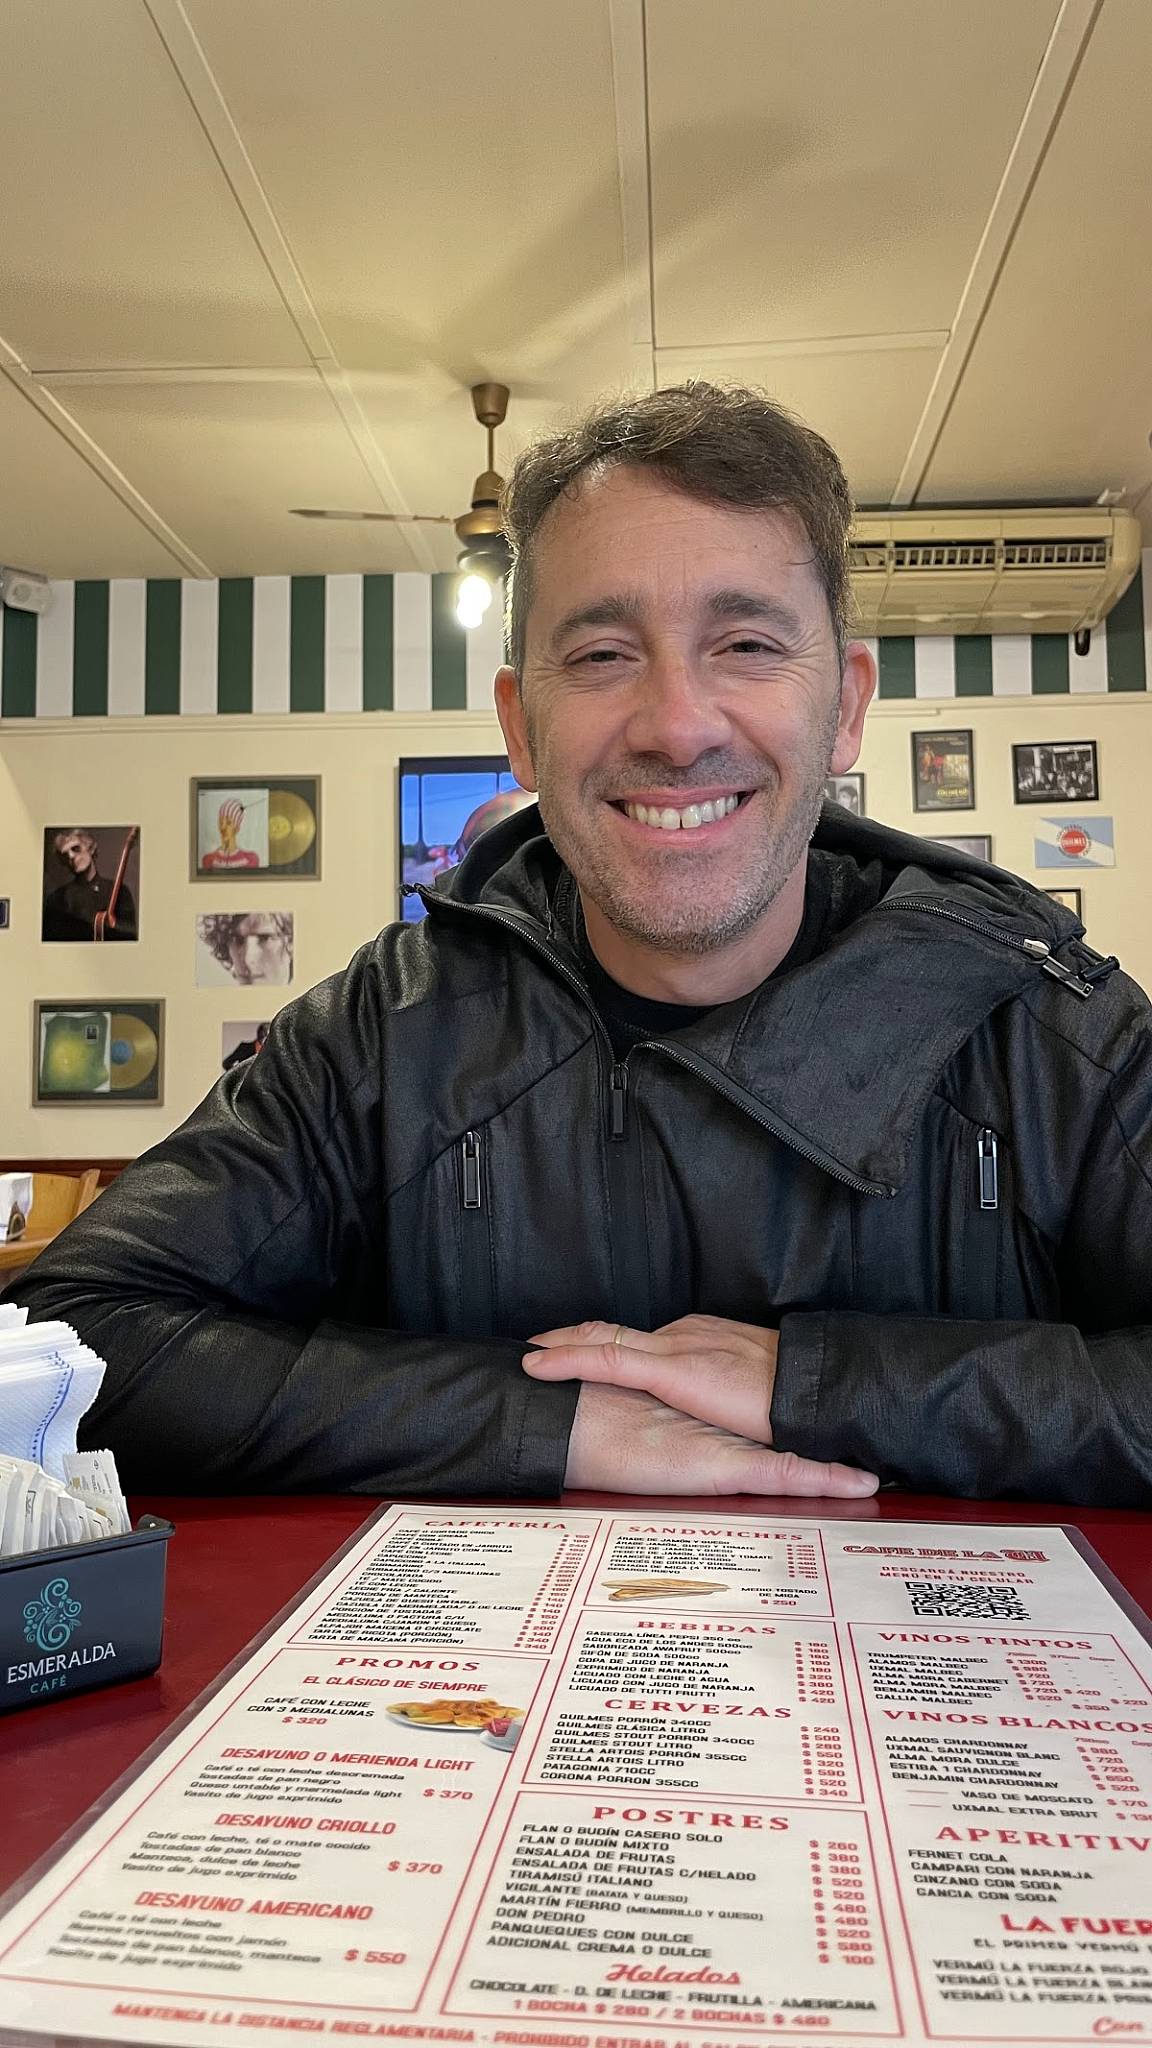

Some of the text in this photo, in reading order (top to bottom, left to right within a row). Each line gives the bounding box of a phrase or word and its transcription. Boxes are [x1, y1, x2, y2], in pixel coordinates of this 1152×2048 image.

[425, 1521, 566, 1529] CAFETERÍA
[630, 1527, 802, 1540] SANDWICHES
[638, 1621, 776, 1634] BEBIDAS
[879, 1633, 1092, 1650] VINOS TINTOS
[7, 1642, 117, 1684] ESMERALDA
[337, 1657, 479, 1671] PROMOS
[575, 1664, 637, 1672] EXPRIMIDO
[30, 1674, 67, 1694] CAFÉ
[302, 1675, 487, 1692] EL CLÁSICO DE SIEMPRE
[568, 1684, 618, 1692] LICUADO
[675, 1690, 716, 1698] FRUTTI
[571, 1677, 619, 1685] LICUADO
[701, 1684, 755, 1692] NARANJA
[300, 1698, 327, 1706] CON
[329, 1700, 370, 1708] LECHE
[605, 1699, 791, 1718] CERVEZAS
[290, 1707, 375, 1717] MEDIALUNAS
[559, 1713, 711, 1727] QUILMES PORRÓN 340CC
[281, 1716, 328, 1725] $ 320
[557, 1721, 706, 1734] QUILMES CLÁSICA LITRO
[883, 1710, 1152, 1734] VINOS BLANCOS
[551, 1737, 693, 1750] QUILMES STOUT LITRO
[554, 1729, 755, 1745] QUILMES STOUT PORRON 340CC
[885, 1735, 1028, 1750] ALAMOS CHARDONNAY
[221, 1748, 474, 1771] DESAYUNO O MERIENDA LIGHT
[546, 1754, 684, 1767] STELLA ARTOIS LITRO
[549, 1746, 747, 1762] STELLA ARTOIS PORRÓN 355CC
[886, 1744, 1061, 1761] UXMAL SAUVIGNON BLANC
[889, 1753, 1019, 1767] ALMA MORA DULCE
[543, 1762, 656, 1775] PATAGONIA 710CC
[889, 1762, 938, 1772] ESTIBA
[954, 1766, 1042, 1778] CHARDONNAY
[540, 1772, 699, 1788] CORONA PORRON 355CC
[892, 1772, 1058, 1789] BENJAMIN CHARDONNAY
[423, 1788, 473, 1800] $ 370
[961, 1791, 1093, 1805] VASO DE MOSCATO
[594, 1807, 788, 1830] POSTRES
[952, 1804, 1098, 1818] UXMAL EXTRA BRUT
[215, 1813, 396, 1835] DESAYUNO CRIOLLO
[522, 1824, 723, 1843] FLAN O BUDÍN CASERO SOLO
[519, 1835, 669, 1851] FLAN O BUDÍN MIXTO
[516, 1847, 675, 1864] ENSALADA DE FRUTAS
[908, 1849, 1008, 1863] FERNET COLA
[387, 1860, 443, 1875] $ 370
[911, 1862, 1093, 1879] CAMPARI CON NARANJA
[511, 1870, 653, 1888] TIRAMISÚ ITALIANO
[913, 1874, 1062, 1890] CINZANO CON SODA
[135, 1892, 373, 1920] DESAYUNO AMERICANO
[496, 1907, 585, 1923] DON PEDRO
[1001, 1914, 1054, 1932] LA
[491, 1921, 692, 1944] PANQUEQUES CON DULCE
[487, 1936, 710, 1958] ADICIONAL CREMA O DULCE
[344, 1949, 407, 1965] $ 550
[606, 1964, 740, 1985] Helados
